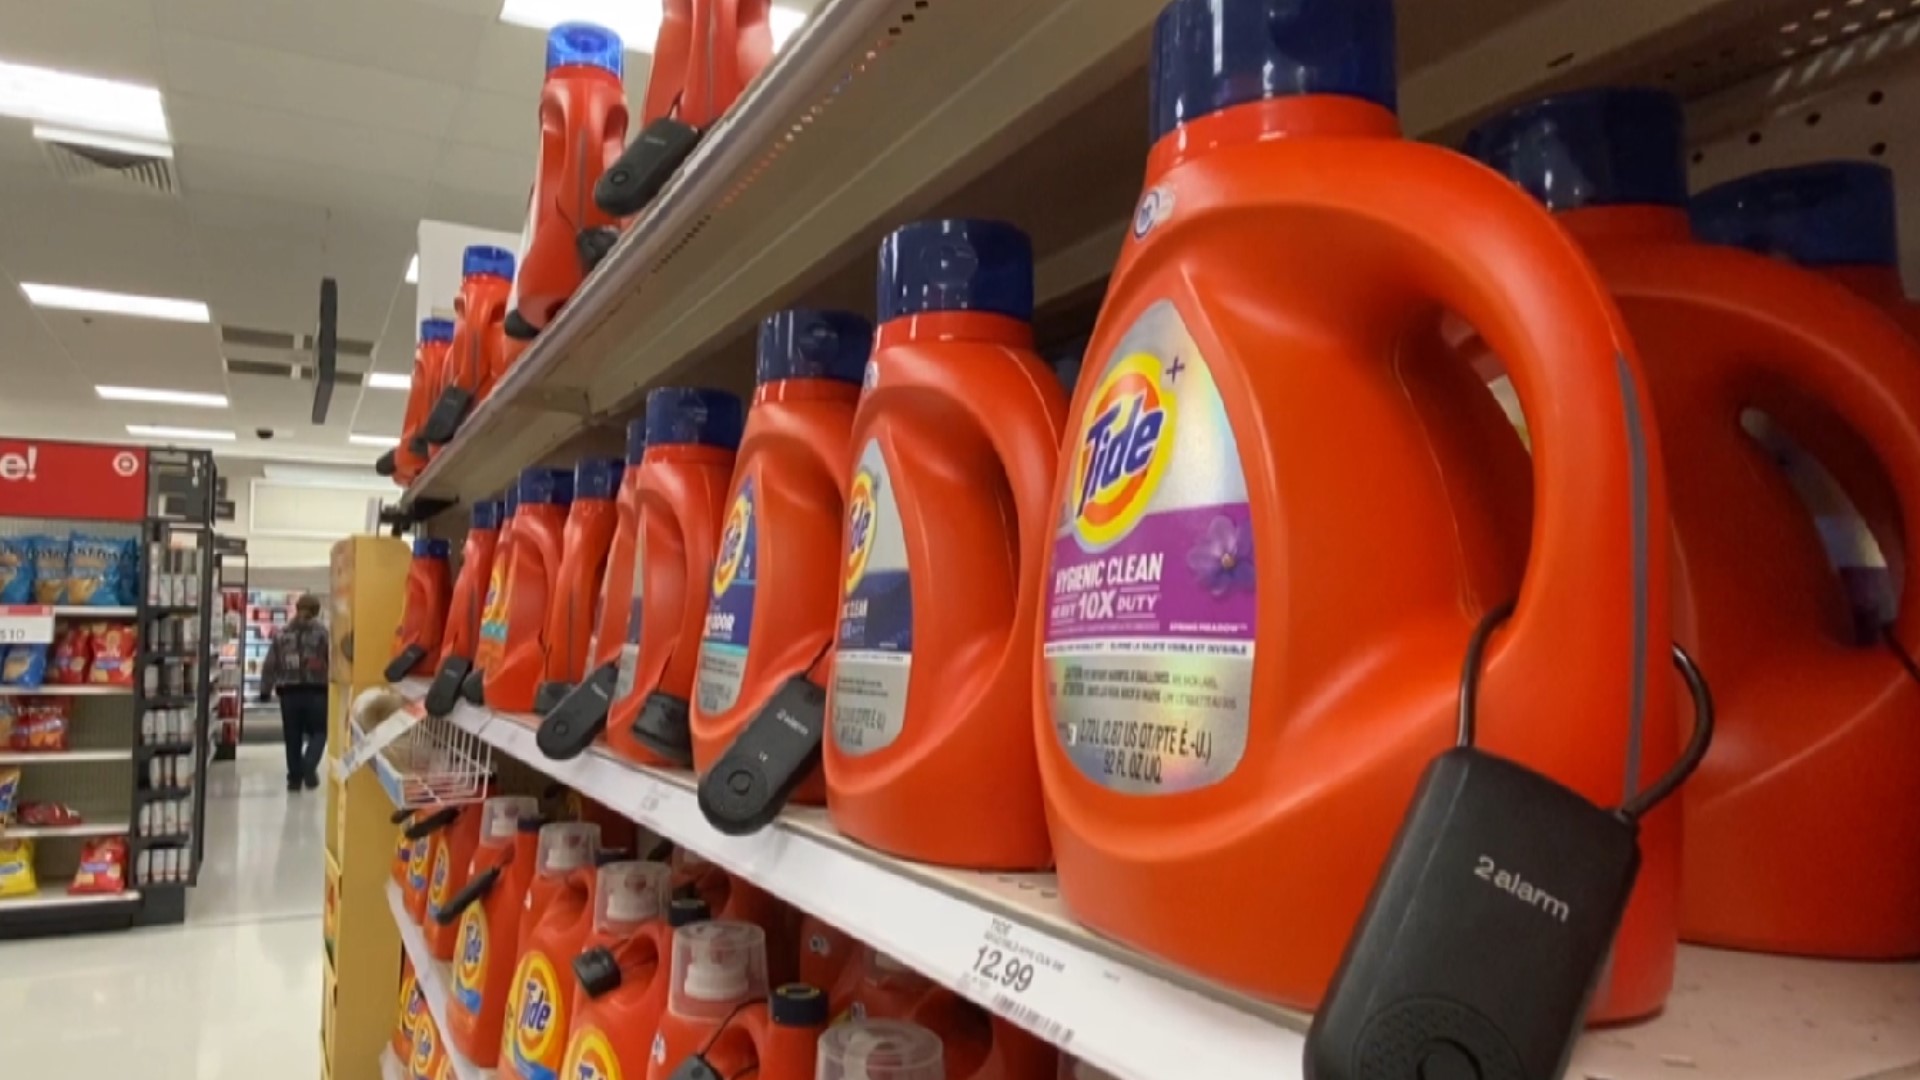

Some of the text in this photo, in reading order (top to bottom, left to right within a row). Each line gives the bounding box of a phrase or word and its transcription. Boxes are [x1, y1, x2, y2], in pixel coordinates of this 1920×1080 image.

[1076, 392, 1165, 520] Tide
[1107, 552, 1164, 585] CLEAN
[1078, 590, 1117, 621] 10X
[1117, 594, 1159, 612] DUTY
[972, 944, 1035, 993] 12.99
[518, 980, 552, 1031] Tide
